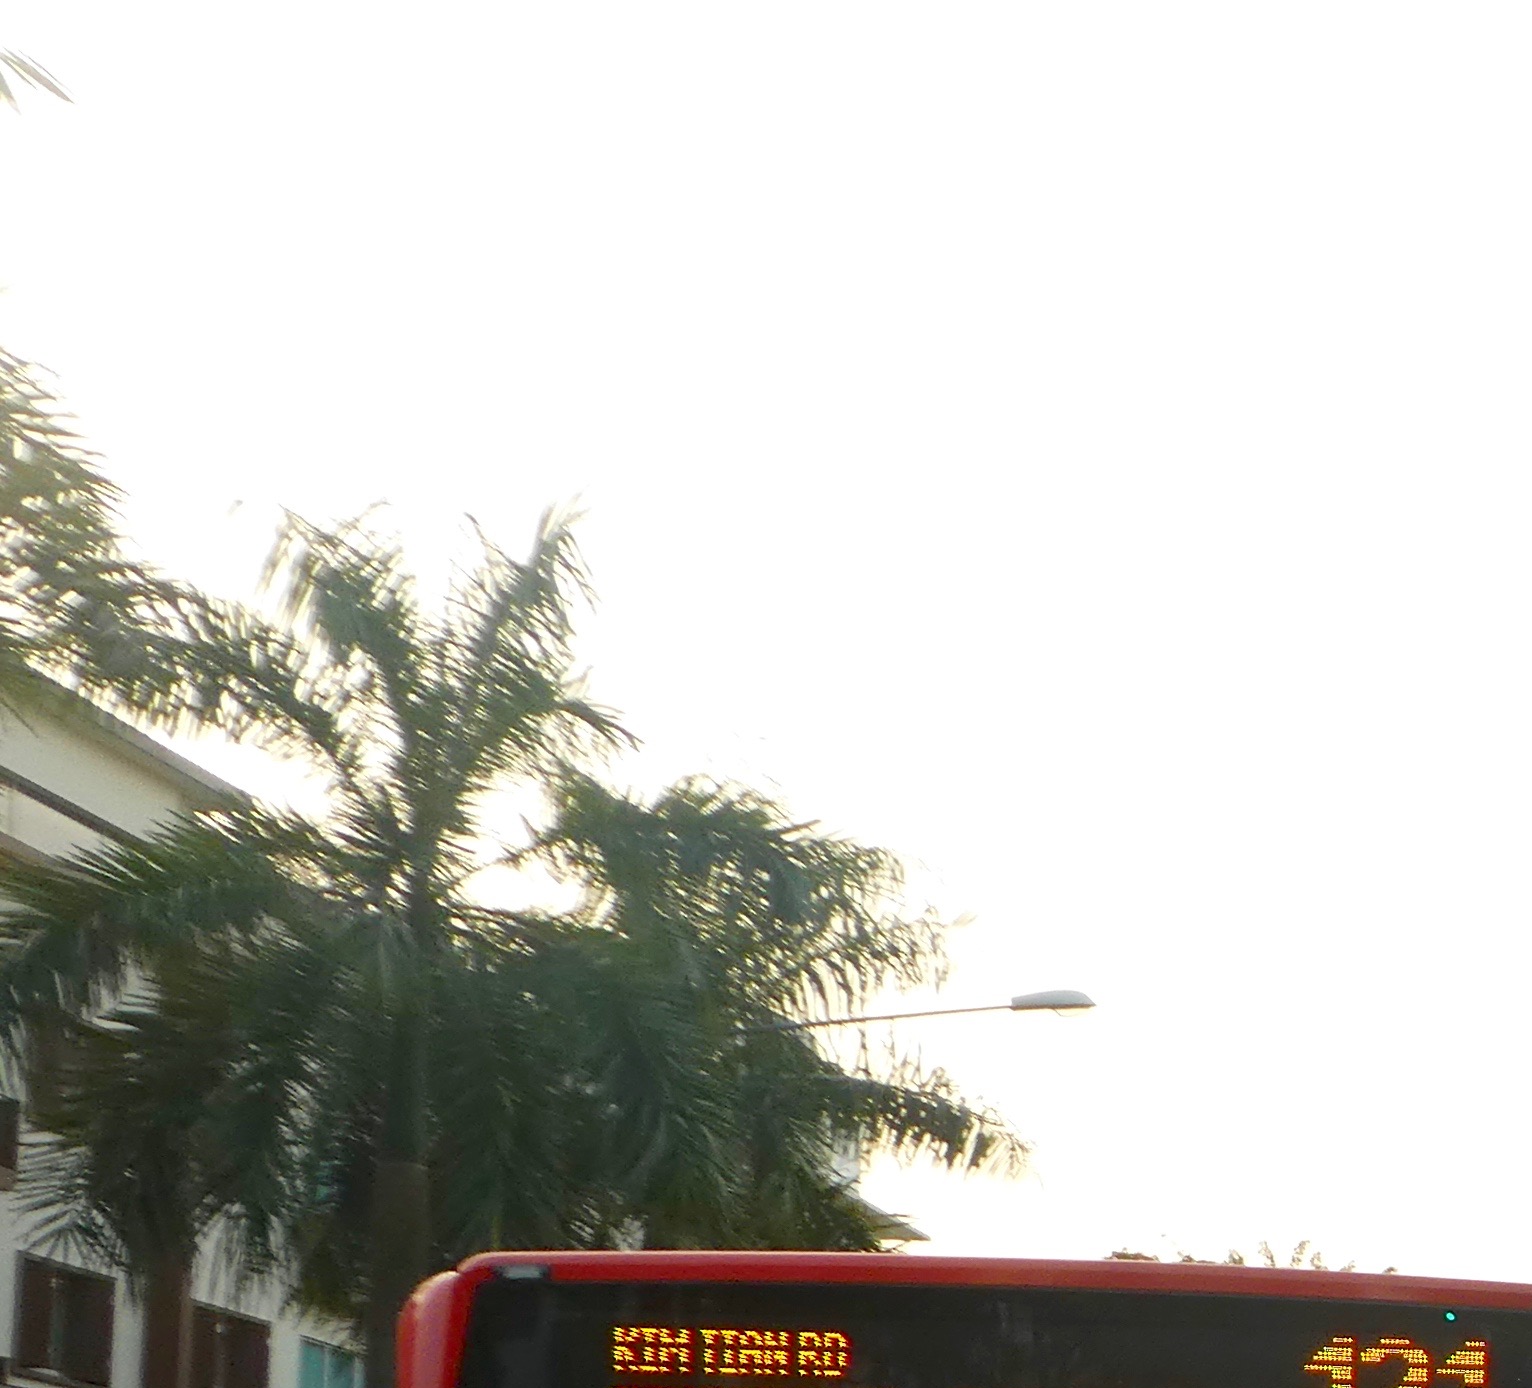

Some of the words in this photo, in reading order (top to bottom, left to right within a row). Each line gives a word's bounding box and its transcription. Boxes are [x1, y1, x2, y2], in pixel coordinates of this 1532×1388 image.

[612, 1325, 693, 1375] KIM
[700, 1327, 791, 1377] TIAN
[797, 1330, 853, 1379] RD
